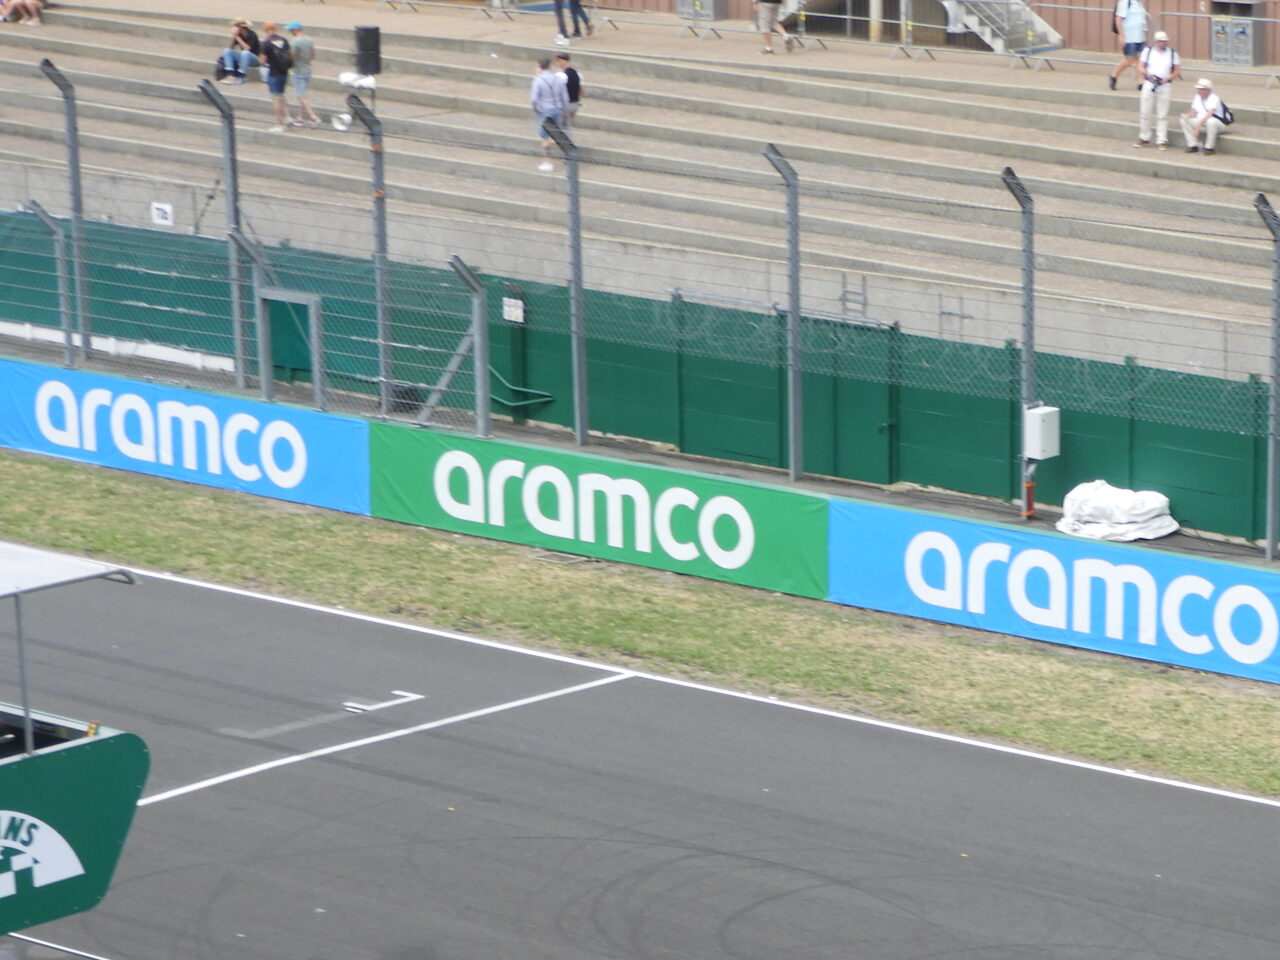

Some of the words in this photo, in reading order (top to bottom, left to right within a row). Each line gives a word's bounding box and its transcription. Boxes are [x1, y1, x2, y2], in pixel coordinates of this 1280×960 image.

[35, 380, 308, 489] aramco
[433, 449, 756, 571] aramco
[904, 530, 1280, 665] aramco
